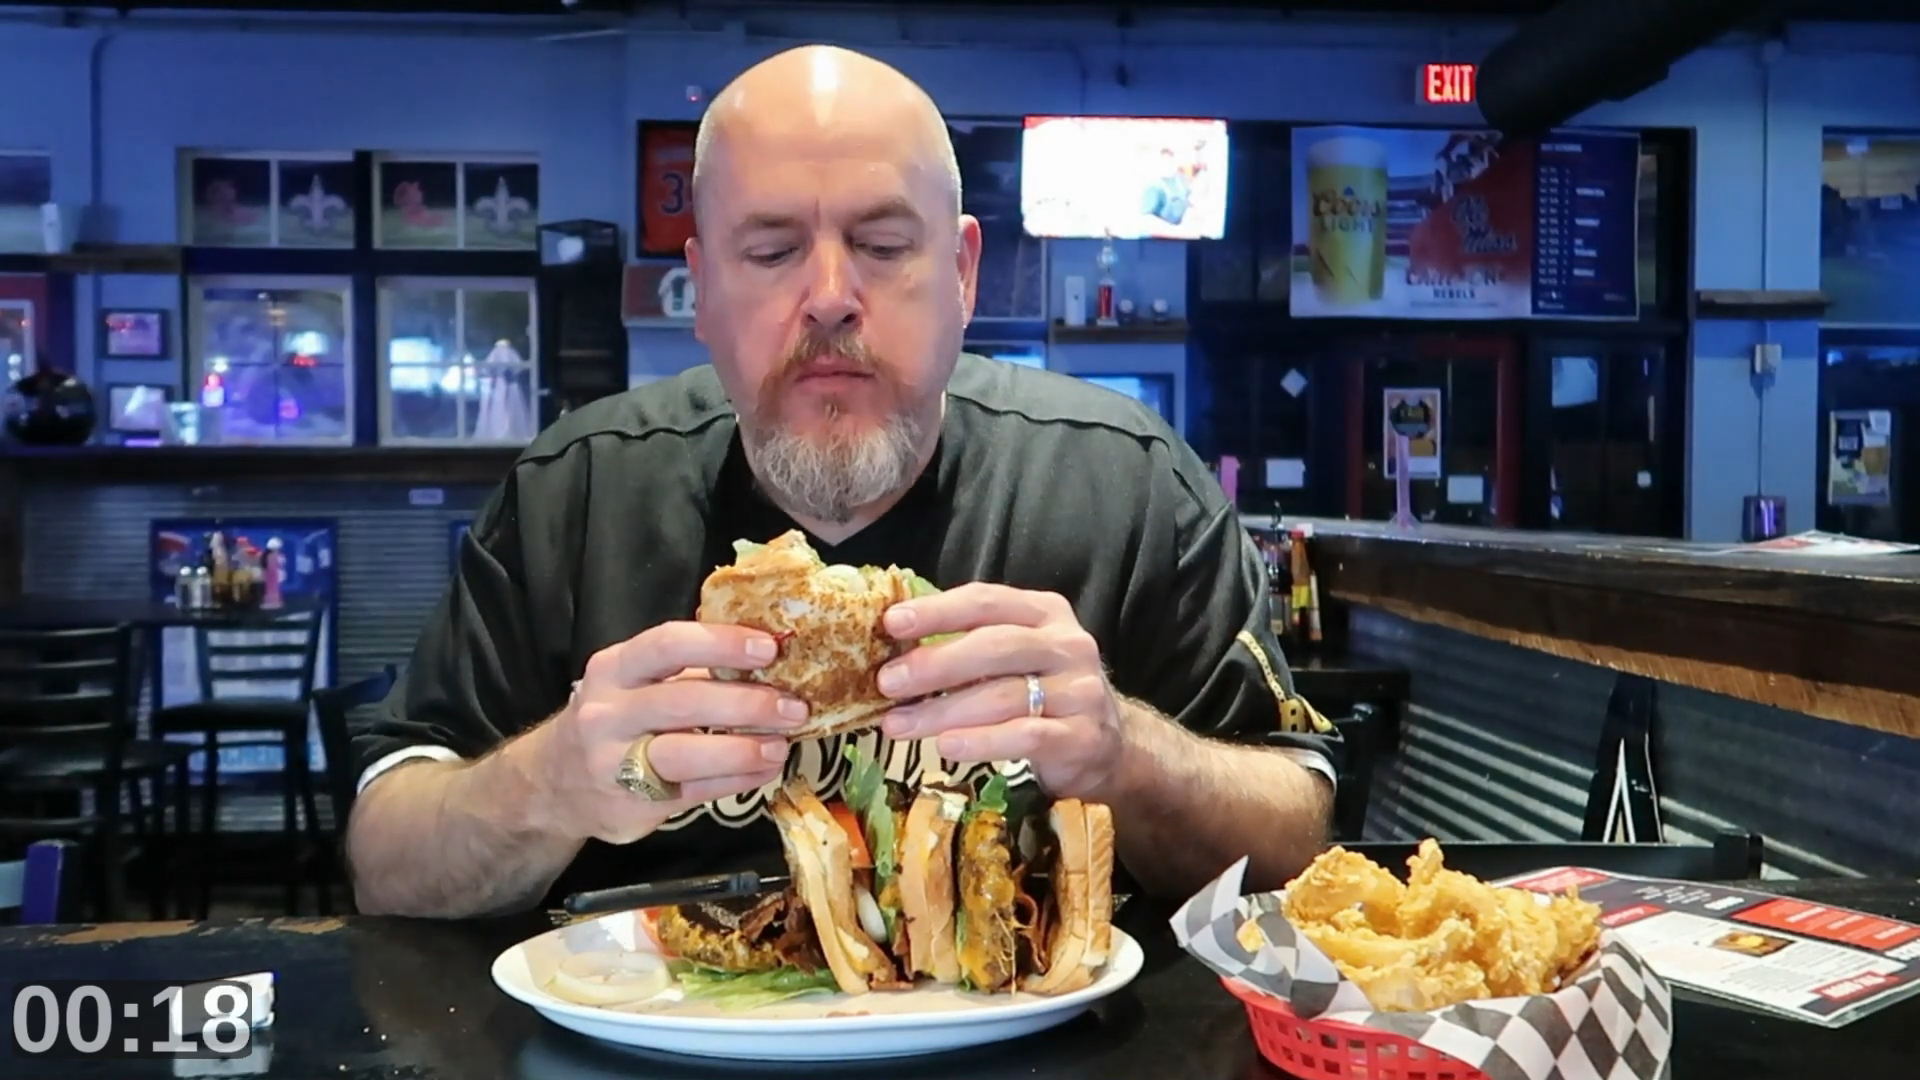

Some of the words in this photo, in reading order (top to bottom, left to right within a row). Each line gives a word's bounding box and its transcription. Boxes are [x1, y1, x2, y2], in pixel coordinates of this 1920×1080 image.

[1427, 64, 1473, 102] EXIT
[1319, 217, 1374, 233] LIGHT
[1433, 288, 1476, 300] REBELS
